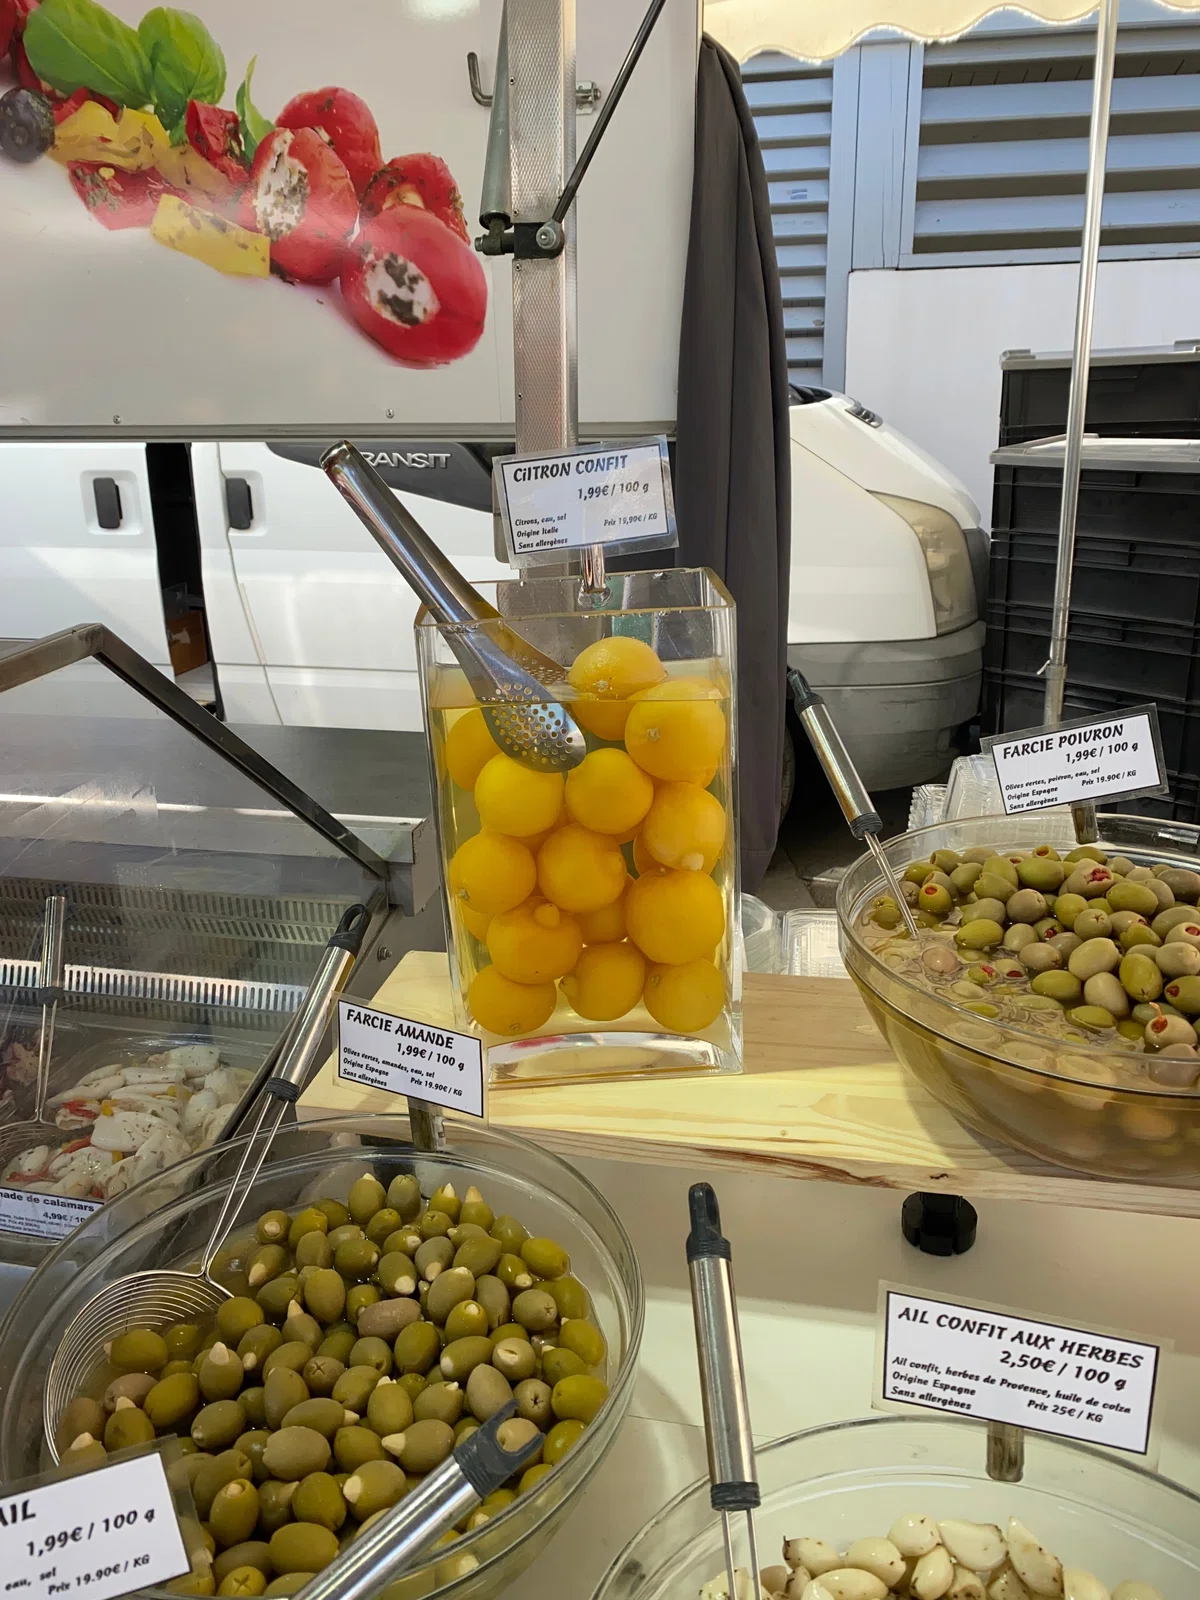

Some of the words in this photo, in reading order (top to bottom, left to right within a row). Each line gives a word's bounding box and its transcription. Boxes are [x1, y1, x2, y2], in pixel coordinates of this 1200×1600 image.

[360, 452, 451, 468] RANSIT
[575, 455, 628, 474] CONFIT
[578, 484, 609, 501] 1,99€
[620, 481, 639, 493] 100
[643, 483, 649, 493] g
[515, 518, 539, 526] Citrons,
[557, 513, 567, 521] sel
[604, 518, 616, 526] Prix
[648, 512, 658, 520] KG
[517, 529, 540, 538] Origine
[535, 537, 568, 548] allergènes
[1003, 738, 1054, 759] FARCIE
[1058, 724, 1124, 748] POIVRON
[1066, 748, 1098, 764] 1,99€
[1108, 742, 1128, 754] 100
[1132, 742, 1138, 752] g
[1005, 783, 1024, 791] Olives
[1025, 779, 1047, 788] vertes,
[1048, 773, 1074, 783] poivron,
[1082, 779, 1094, 787] Prix
[1097, 773, 1121, 784] 19.90€
[1007, 792, 1030, 801] Origine
[1032, 786, 1058, 797] Espagne
[1009, 802, 1024, 811] Sans
[1026, 796, 1058, 808] allergènes
[347, 1009, 392, 1032] FARCIE
[395, 1024, 454, 1049] AMANDE
[343, 1047, 360, 1057] Olives
[361, 1052, 380, 1064] vertes,
[382, 1059, 409, 1073] amandes,
[410, 1068, 424, 1076] eau,
[426, 1070, 435, 1078] sel
[397, 1043, 427, 1058] 1,99€
[436, 1053, 455, 1066] 100
[458, 1062, 465, 1071] g
[343, 1058, 364, 1069] Origine
[365, 1064, 389, 1076] Espagne
[343, 1068, 356, 1078] Sans
[358, 1073, 387, 1086] allergènes
[410, 1077, 422, 1086] Prix
[424, 1080, 448, 1092] 19.90€
[453, 1088, 462, 1096] KG
[27, 1195, 40, 1204] de
[43, 1200, 95, 1212] calamars
[43, 1212, 67, 1221] 4,99€
[898, 1307, 929, 1325] AIL
[936, 1314, 1008, 1340] CONFIT
[1010, 1330, 1056, 1350] AUX
[1059, 1339, 1145, 1369] HERBES
[1000, 1350, 1056, 1373] 2,50€
[1074, 1365, 1110, 1384] 100
[1115, 1377, 1127, 1391] g
[892, 1371, 929, 1388] Origine
[932, 1379, 976, 1396] Espagne
[892, 1356, 907, 1366] Ail
[908, 1358, 942, 1375] confit,
[946, 1366, 980, 1382] herbes
[983, 1374, 996, 1385] de
[1000, 1378, 1052, 1399] Provence,
[1055, 1390, 1083, 1404] huile
[1086, 1396, 1100, 1407] de
[1102, 1401, 1131, 1414] colza
[891, 1386, 916, 1399] Sans
[918, 1392, 972, 1410] allergènes
[1027, 1399, 1049, 1412] Prix
[1051, 1404, 1076, 1417] 25€
[1086, 1411, 1103, 1424] KG
[27, 1526, 83, 1557] 1,99€
[102, 1510, 138, 1533] 100
[144, 1508, 155, 1522] g
[5, 1579, 31, 1591] eau,
[40, 1567, 57, 1581] sel
[48, 1582, 70, 1595] Prix
[76, 1564, 121, 1586] 19.90€
[133, 1554, 150, 1568] KG
